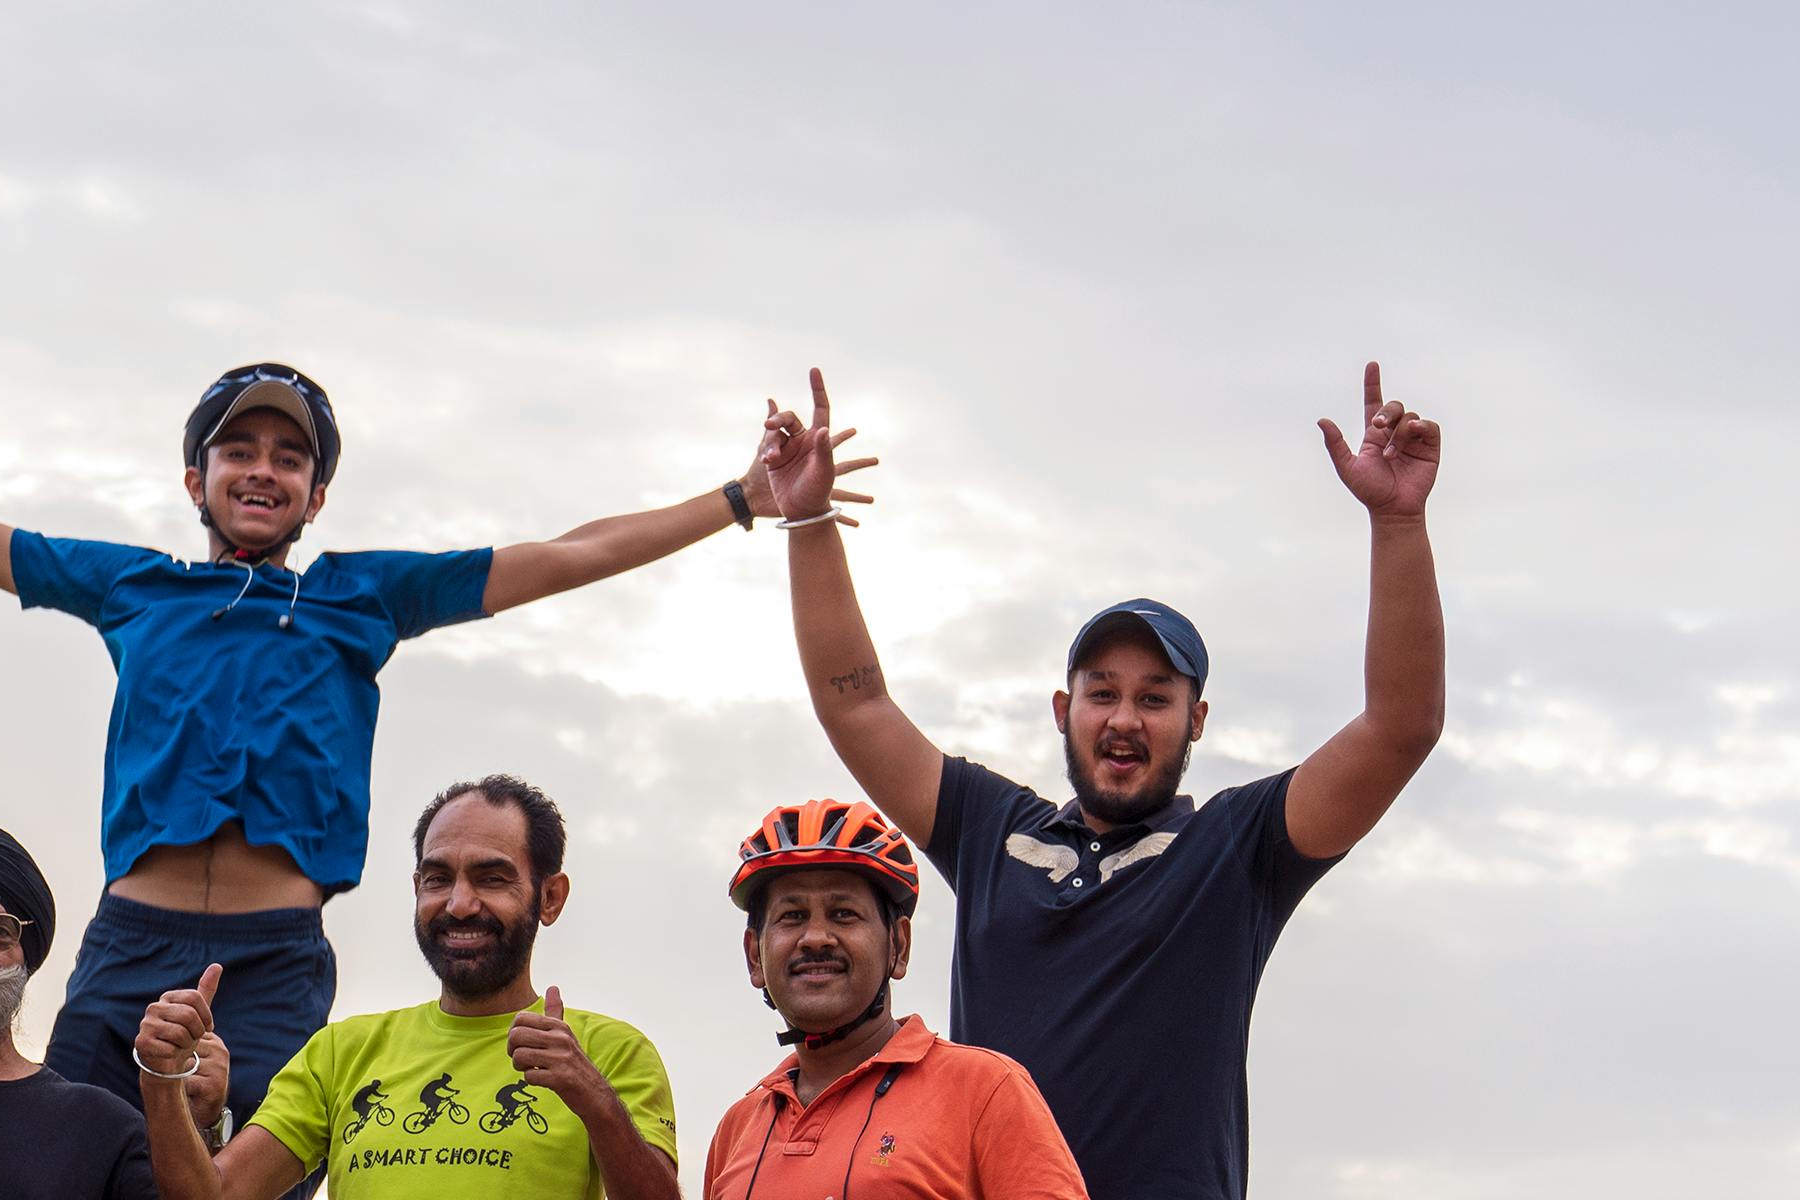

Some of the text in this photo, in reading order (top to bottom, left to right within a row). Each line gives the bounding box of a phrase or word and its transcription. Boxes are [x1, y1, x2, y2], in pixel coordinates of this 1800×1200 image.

[349, 1147, 513, 1173] A SMART CHOICE
